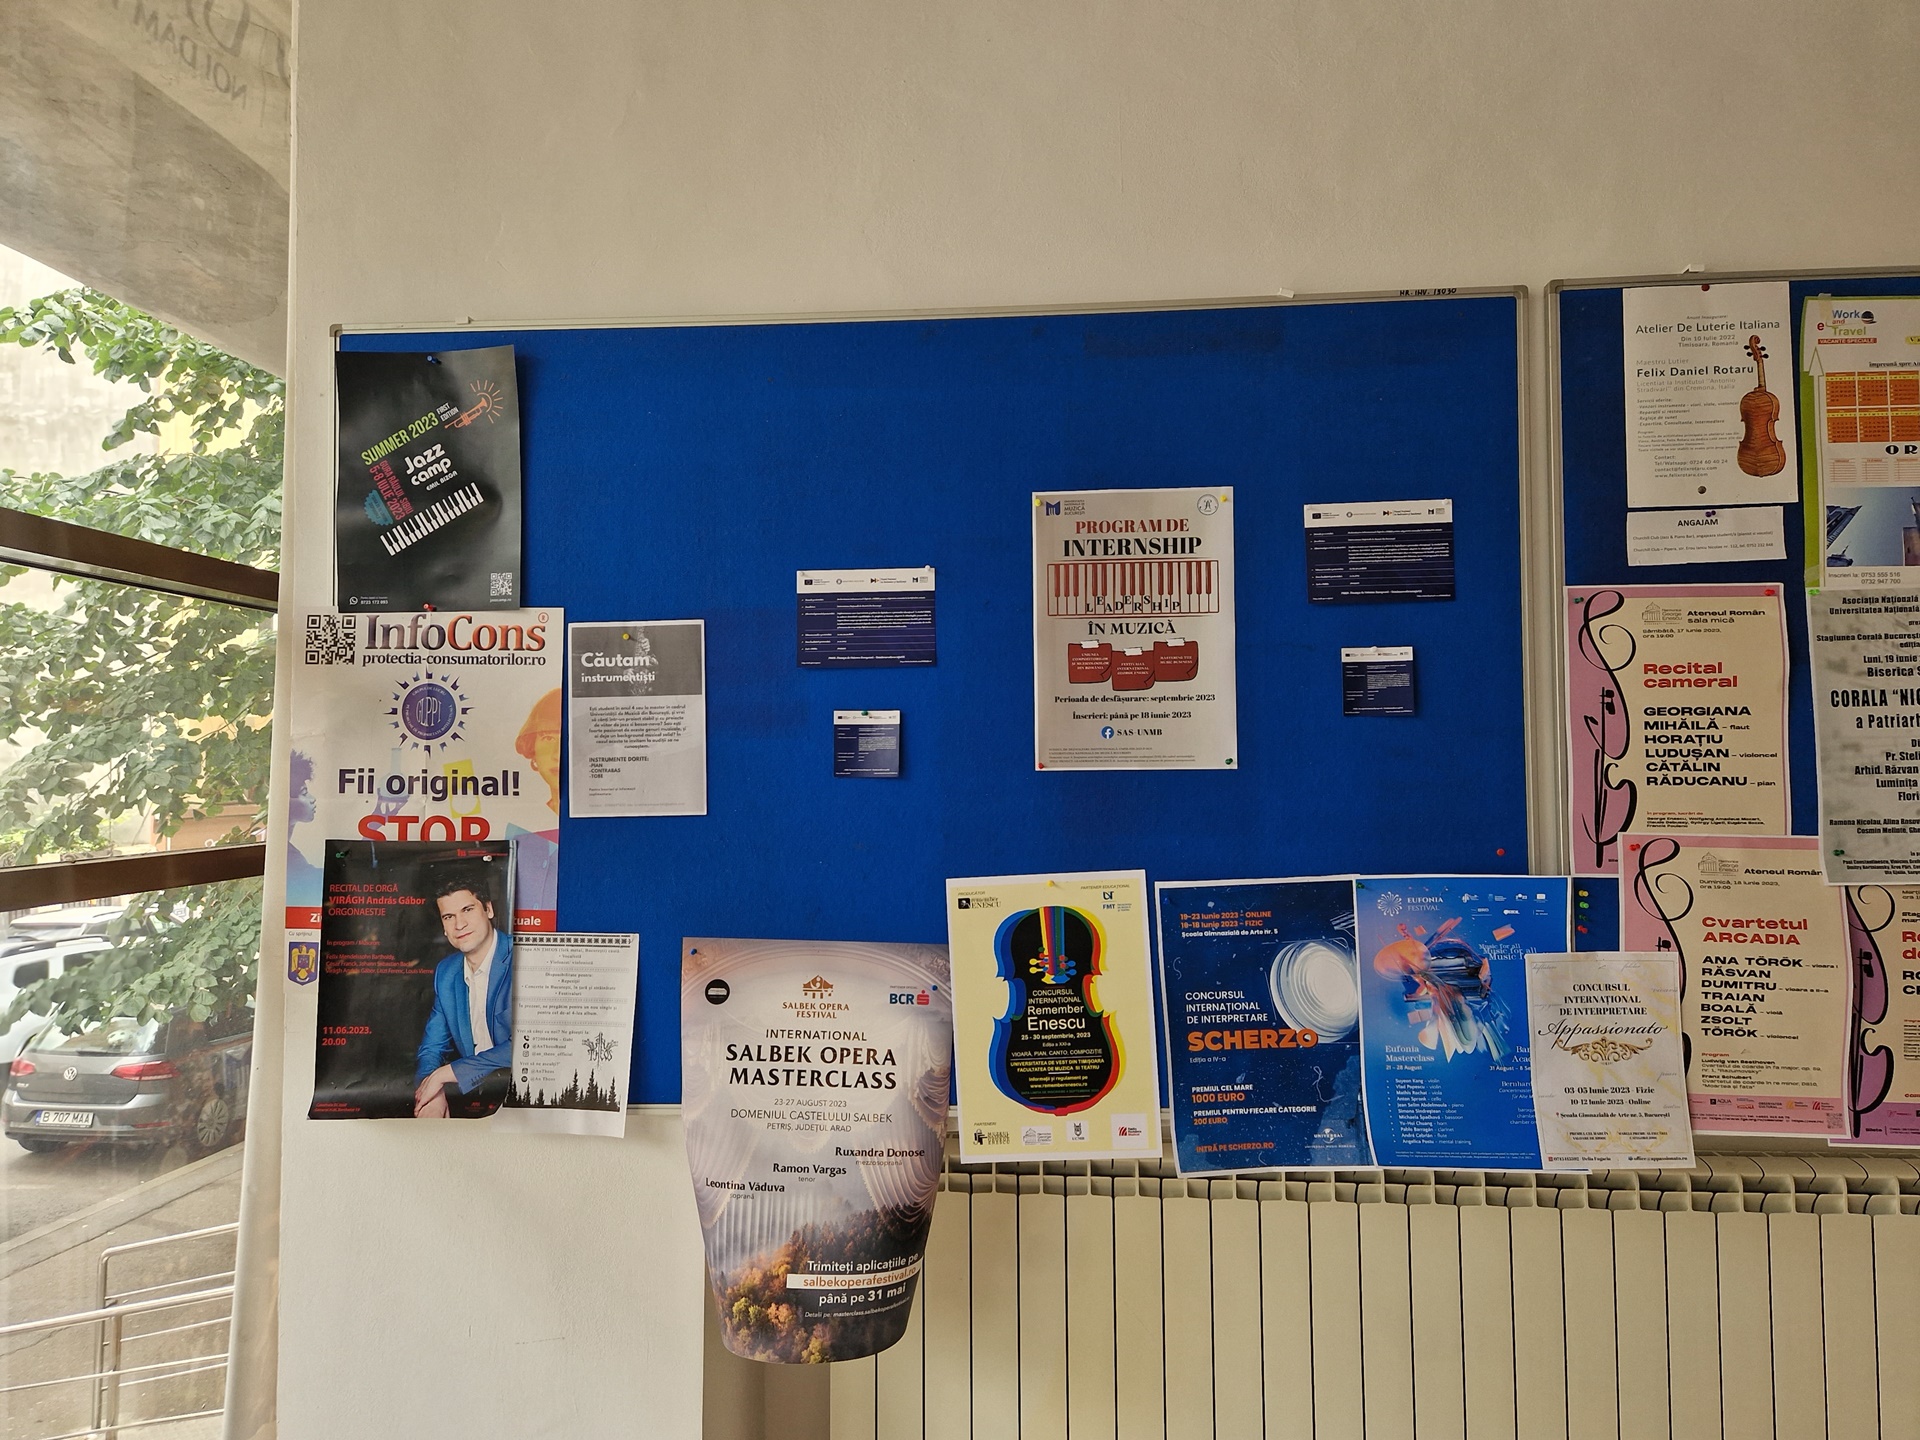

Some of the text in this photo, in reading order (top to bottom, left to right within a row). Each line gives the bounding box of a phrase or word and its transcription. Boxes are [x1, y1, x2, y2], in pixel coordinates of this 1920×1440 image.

[1832, 310, 1860, 318] Work
[1636, 320, 1780, 334] Atelier De Luterie Italiana
[1832, 326, 1866, 336] Travel
[1637, 366, 1754, 377] Felix Daniel Rotaru
[436, 402, 450, 414] FIRST
[440, 407, 459, 421] EDITION
[361, 412, 438, 465] SUMMER 2023
[405, 444, 445, 474] Jazz
[411, 458, 451, 486] camp
[377, 480, 405, 520] IULIE 2023
[1076, 519, 1189, 534] PROGRAM DE
[1063, 537, 1201, 556] INTERNSHIP
[1086, 595, 1180, 612] LEADERSHIP
[365, 614, 546, 651] InfoCons
[1089, 620, 1176, 635] ÎN MUZICĂ
[362, 652, 546, 667] protectia-consumatorilor.ro
[581, 652, 650, 667] Căutam
[1644, 662, 1722, 674] Recital
[1867, 667, 1913, 677] Biserica
[582, 672, 655, 684] instrumentiști
[1644, 676, 1737, 688] cameral
[1101, 695, 1149, 703] desfășurare:
[1150, 695, 1194, 703] septembrie
[1831, 690, 1888, 707] CORALA
[1073, 711, 1108, 719] Înscrieri:
[1109, 712, 1128, 720] până
[1644, 707, 1751, 716] GEORGIANA
[1644, 718, 1719, 730] MIHĂILĂ
[1645, 735, 1722, 747] HORAȚIU
[1646, 749, 1729, 761] LUDUȘAN
[1646, 760, 1720, 771] CĂTĂLIN
[1855, 765, 1918, 775] Arhid. Răzvan
[338, 768, 520, 802] Fii original!
[1647, 774, 1747, 785] RĂDUCANU
[1876, 779, 1917, 789] Luminița
[330, 884, 398, 892] RECITAL DE ORGĂ
[329, 895, 425, 904] VIRÁGH András Gábor
[1702, 917, 1808, 930] Cvartetul
[1703, 932, 1800, 945] ARCADIA
[1702, 956, 1803, 968] ANA TÖRÖK
[1702, 966, 1771, 978] RĂSVAN
[1573, 984, 1630, 992] CONCURSUL
[1702, 980, 1776, 990] DUMITRU
[890, 994, 914, 1004] BCR
[1029, 997, 1081, 1005] INTERNAȚIONAL
[1185, 991, 1244, 1000] CONCURSUL
[1564, 996, 1641, 1005] INTERNAȚIONAL
[1702, 992, 1765, 1002] TRAIAN
[783, 1002, 849, 1011] SALBEK OPERA
[1028, 1005, 1084, 1015] Remember
[1186, 1002, 1260, 1013] INTERNAȚIONAL
[1559, 1007, 1647, 1016] DE INTERPRETARE
[1701, 1003, 1756, 1014] BOALĂ
[796, 1011, 837, 1019] FESTIVAL
[1187, 1013, 1268, 1024] DE INTERPRETARE
[1701, 1016, 1752, 1025] ZSOLT
[1028, 1016, 1085, 1031] Enescu
[766, 1029, 867, 1041] INTERNATIONAL
[1538, 1018, 1668, 1050] Appassionato
[1702, 1026, 1758, 1038] TÖRÖK
[1187, 1029, 1318, 1051] SCHERZO
[726, 1044, 897, 1066] SALBEK OPERA
[1386, 1045, 1419, 1053] Eufonia
[729, 1067, 897, 1090] MASTERCLASS
[796, 1099, 827, 1107] AUGUST
[1192, 1093, 1245, 1103] 1000 EURO
[42, 1112, 90, 1123] B 707 MAA
[731, 1109, 892, 1123] DOMENIUL CASTELULUI SALBEK
[830, 1124, 851, 1132] ARAD
[835, 1147, 925, 1158] Ruxandra Donose
[773, 1163, 846, 1177] Ramon Vargas
[706, 1177, 785, 1193] Leontina Văduva
[807, 1257, 906, 1274] Trimiteți aplicațiile
[804, 1267, 916, 1289] salbekoperafestival.ro
[819, 1285, 906, 1306] până pe 31 mai
